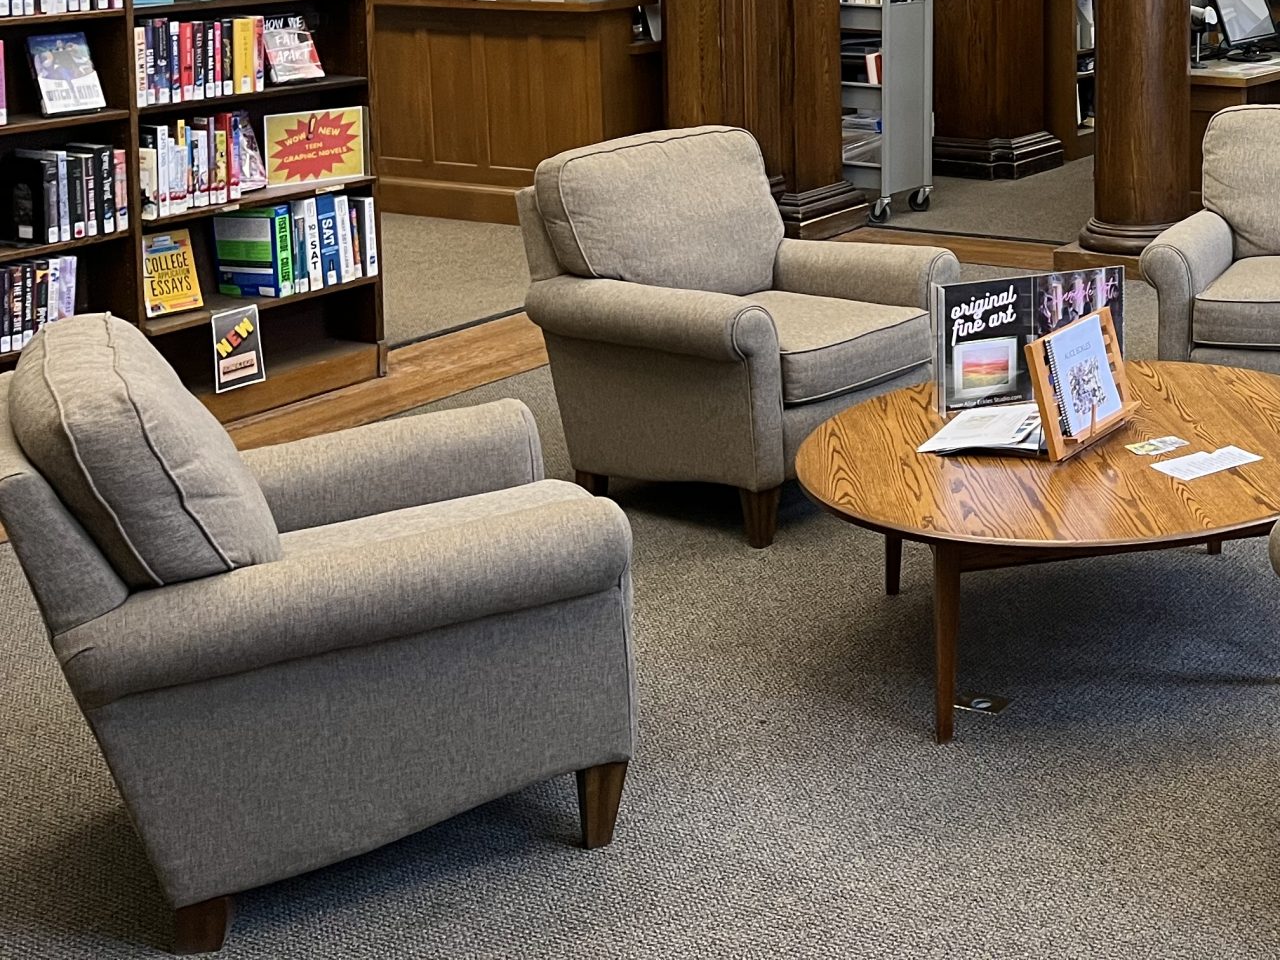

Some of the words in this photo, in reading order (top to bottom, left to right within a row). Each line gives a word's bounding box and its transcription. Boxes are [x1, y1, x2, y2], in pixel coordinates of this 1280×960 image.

[264, 17, 284, 30] HOW
[287, 15, 305, 30] WE
[275, 33, 300, 47] FALL
[276, 47, 308, 66] APART
[138, 63, 145, 74] MY
[138, 76, 146, 91] RAG
[318, 126, 341, 136] NEW
[305, 141, 323, 150] TEEN
[283, 151, 317, 163] GRAPHIC
[319, 146, 347, 156] NOVELS
[278, 217, 288, 235] FISKE
[322, 218, 335, 246] SAT
[279, 234, 289, 253] GUIDE
[145, 251, 189, 275] COLLEGE
[157, 267, 191, 280] APPLICATION
[13, 281, 22, 296] THE
[150, 275, 192, 297] ESSAYS
[13, 297, 22, 315] LAST
[951, 284, 1017, 320] original
[13, 316, 22, 332] SHE
[951, 318, 986, 347] fine
[988, 303, 1017, 328] art
[215, 317, 254, 358] NEW
